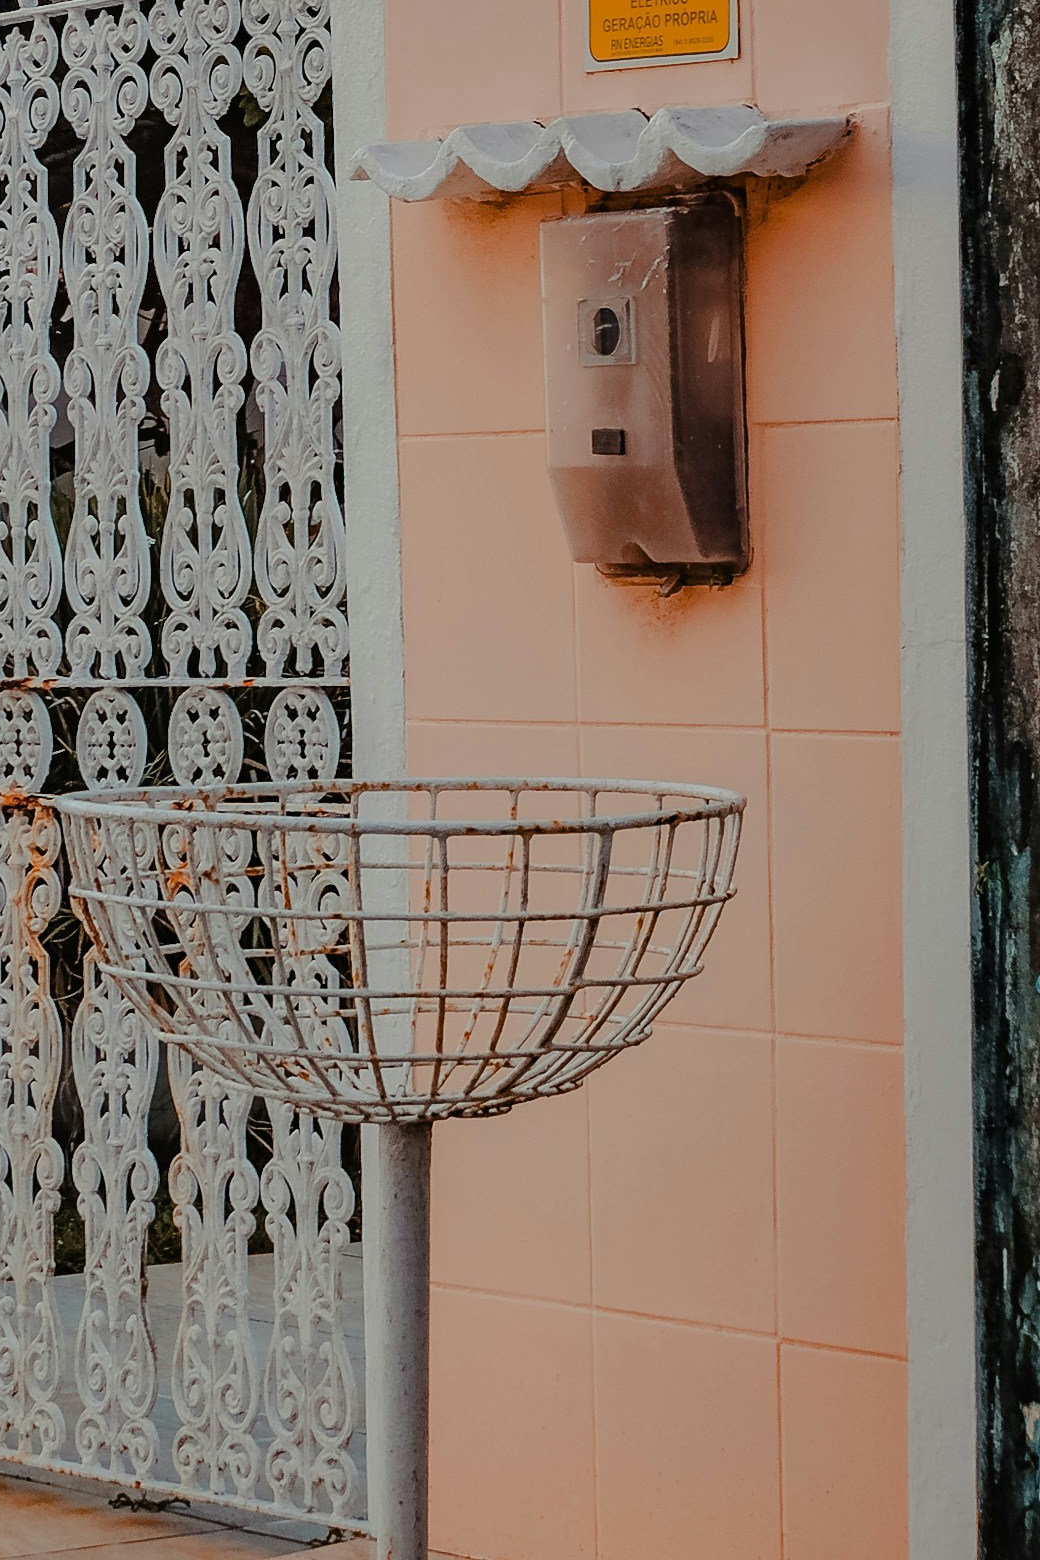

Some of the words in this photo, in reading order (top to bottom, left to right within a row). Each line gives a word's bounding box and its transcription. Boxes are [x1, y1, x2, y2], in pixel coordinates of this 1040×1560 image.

[603, 12, 661, 34] GERAÇÃO
[664, 8, 718, 27] PRÓPRIA
[624, 35, 664, 50] ENERGIAS
